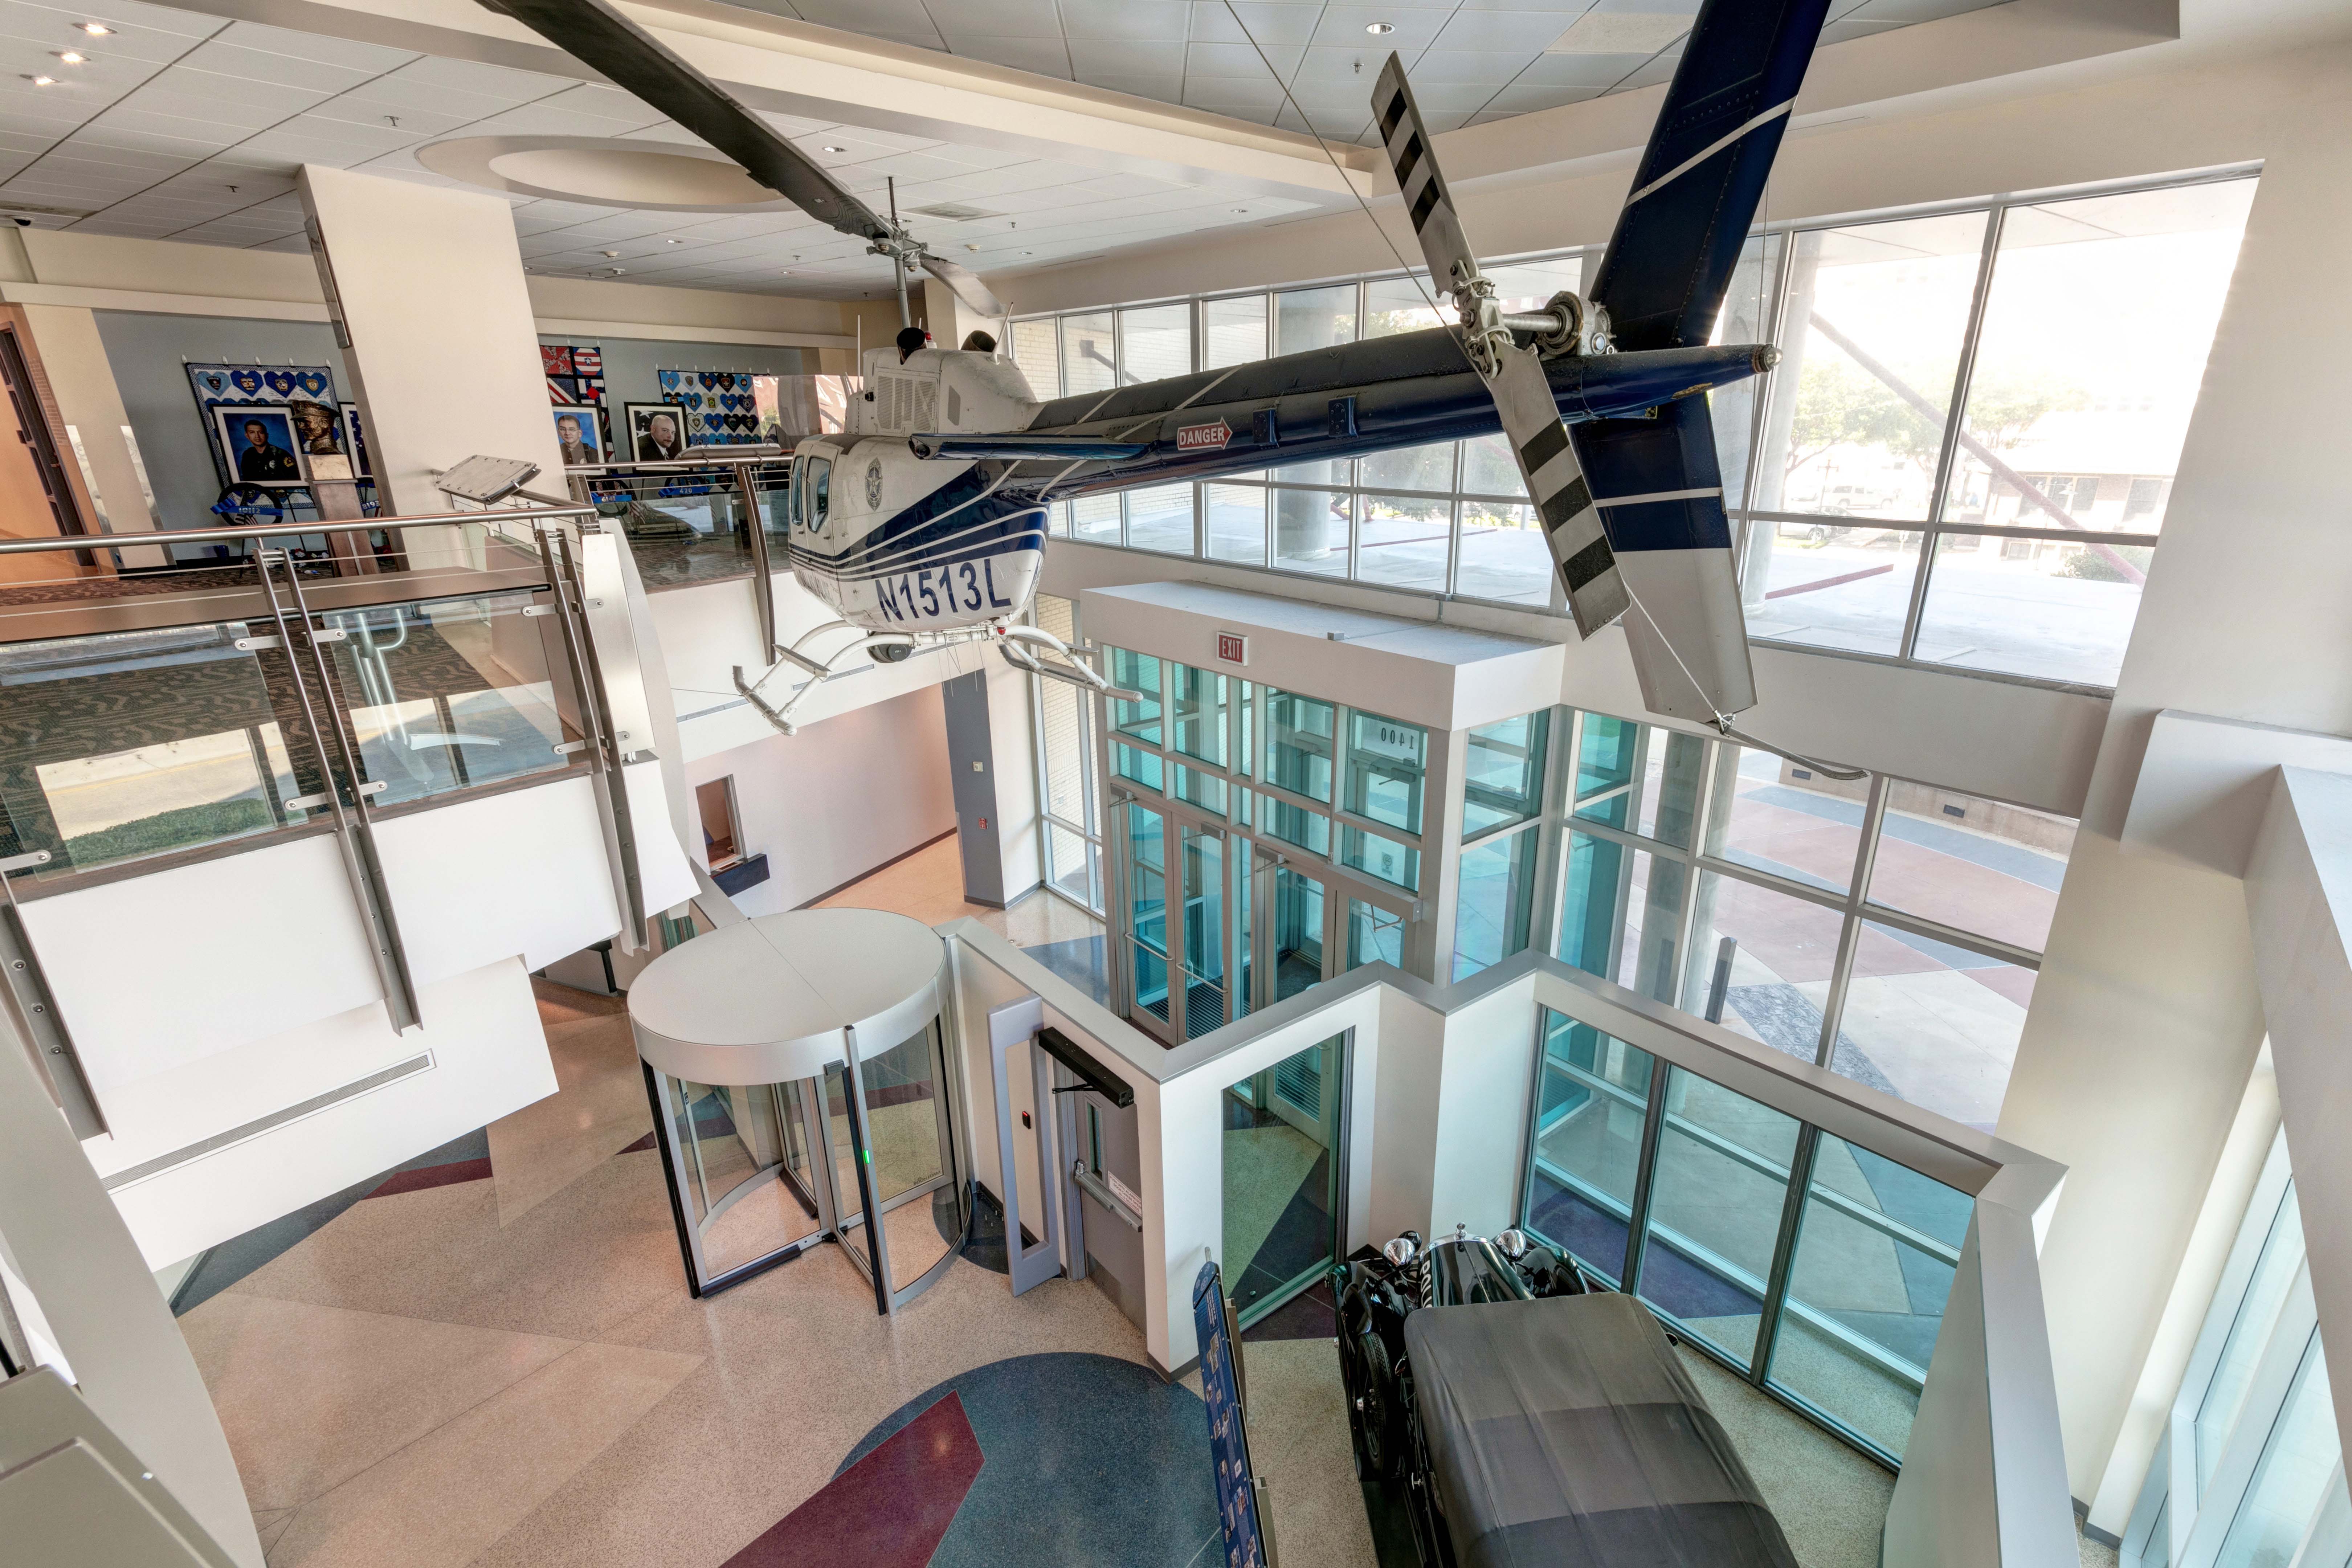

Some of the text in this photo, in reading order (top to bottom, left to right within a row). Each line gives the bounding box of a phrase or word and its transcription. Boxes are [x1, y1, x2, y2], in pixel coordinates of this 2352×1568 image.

[1180, 427, 1225, 445] DANGER
[362, 500, 381, 510] 8193
[875, 558, 1012, 622] N1513L
[1222, 638, 1241, 659] EXIT
[1420, 1260, 1433, 1308] POLI
